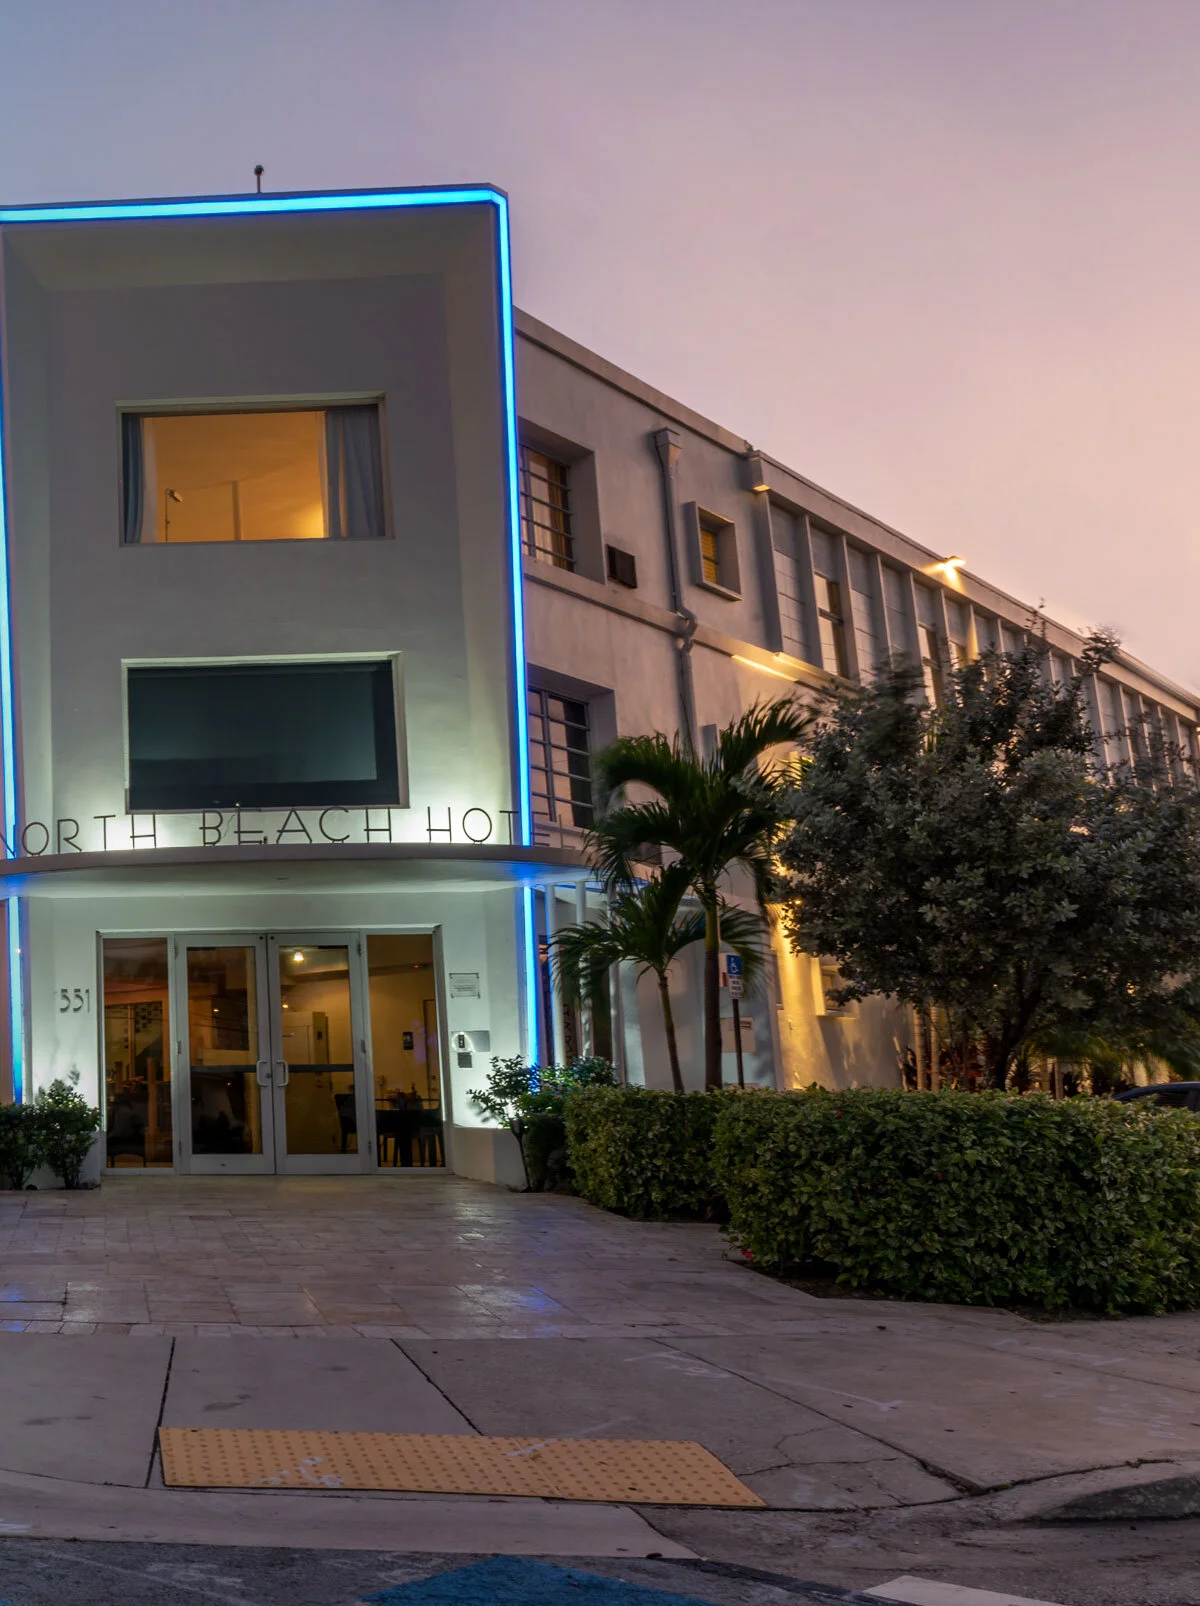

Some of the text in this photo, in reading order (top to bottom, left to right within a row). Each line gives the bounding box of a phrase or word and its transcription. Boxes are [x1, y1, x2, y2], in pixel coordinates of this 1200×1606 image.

[199, 806, 393, 847] BEACH
[426, 806, 576, 849] HOTEL
[59, 988, 90, 1013] 551
